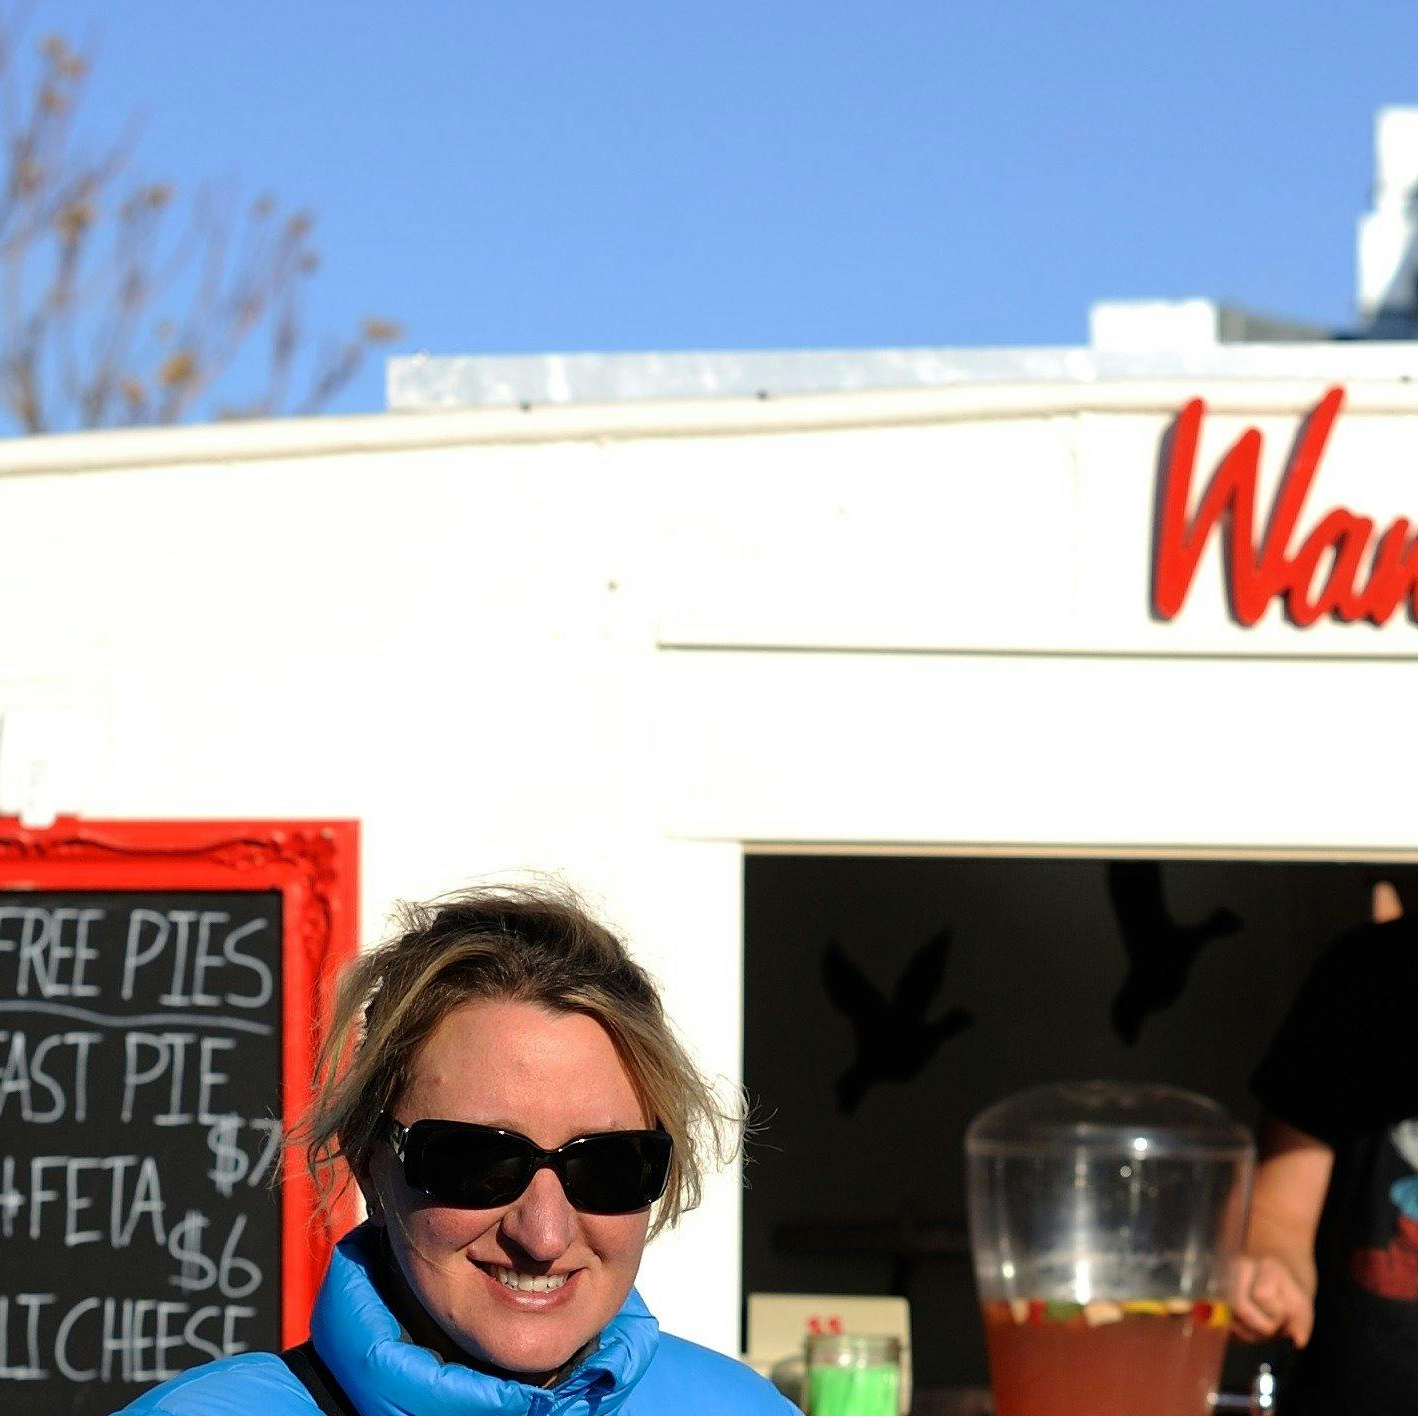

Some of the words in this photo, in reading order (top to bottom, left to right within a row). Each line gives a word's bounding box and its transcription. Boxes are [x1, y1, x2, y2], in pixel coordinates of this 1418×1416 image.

[120, 907, 274, 1009] PIES
[119, 1031, 246, 1127] PIE
[29, 1154, 169, 1248] FETA
[166, 1208, 264, 1299] $6
[54, 1296, 257, 1383] CHEESE
